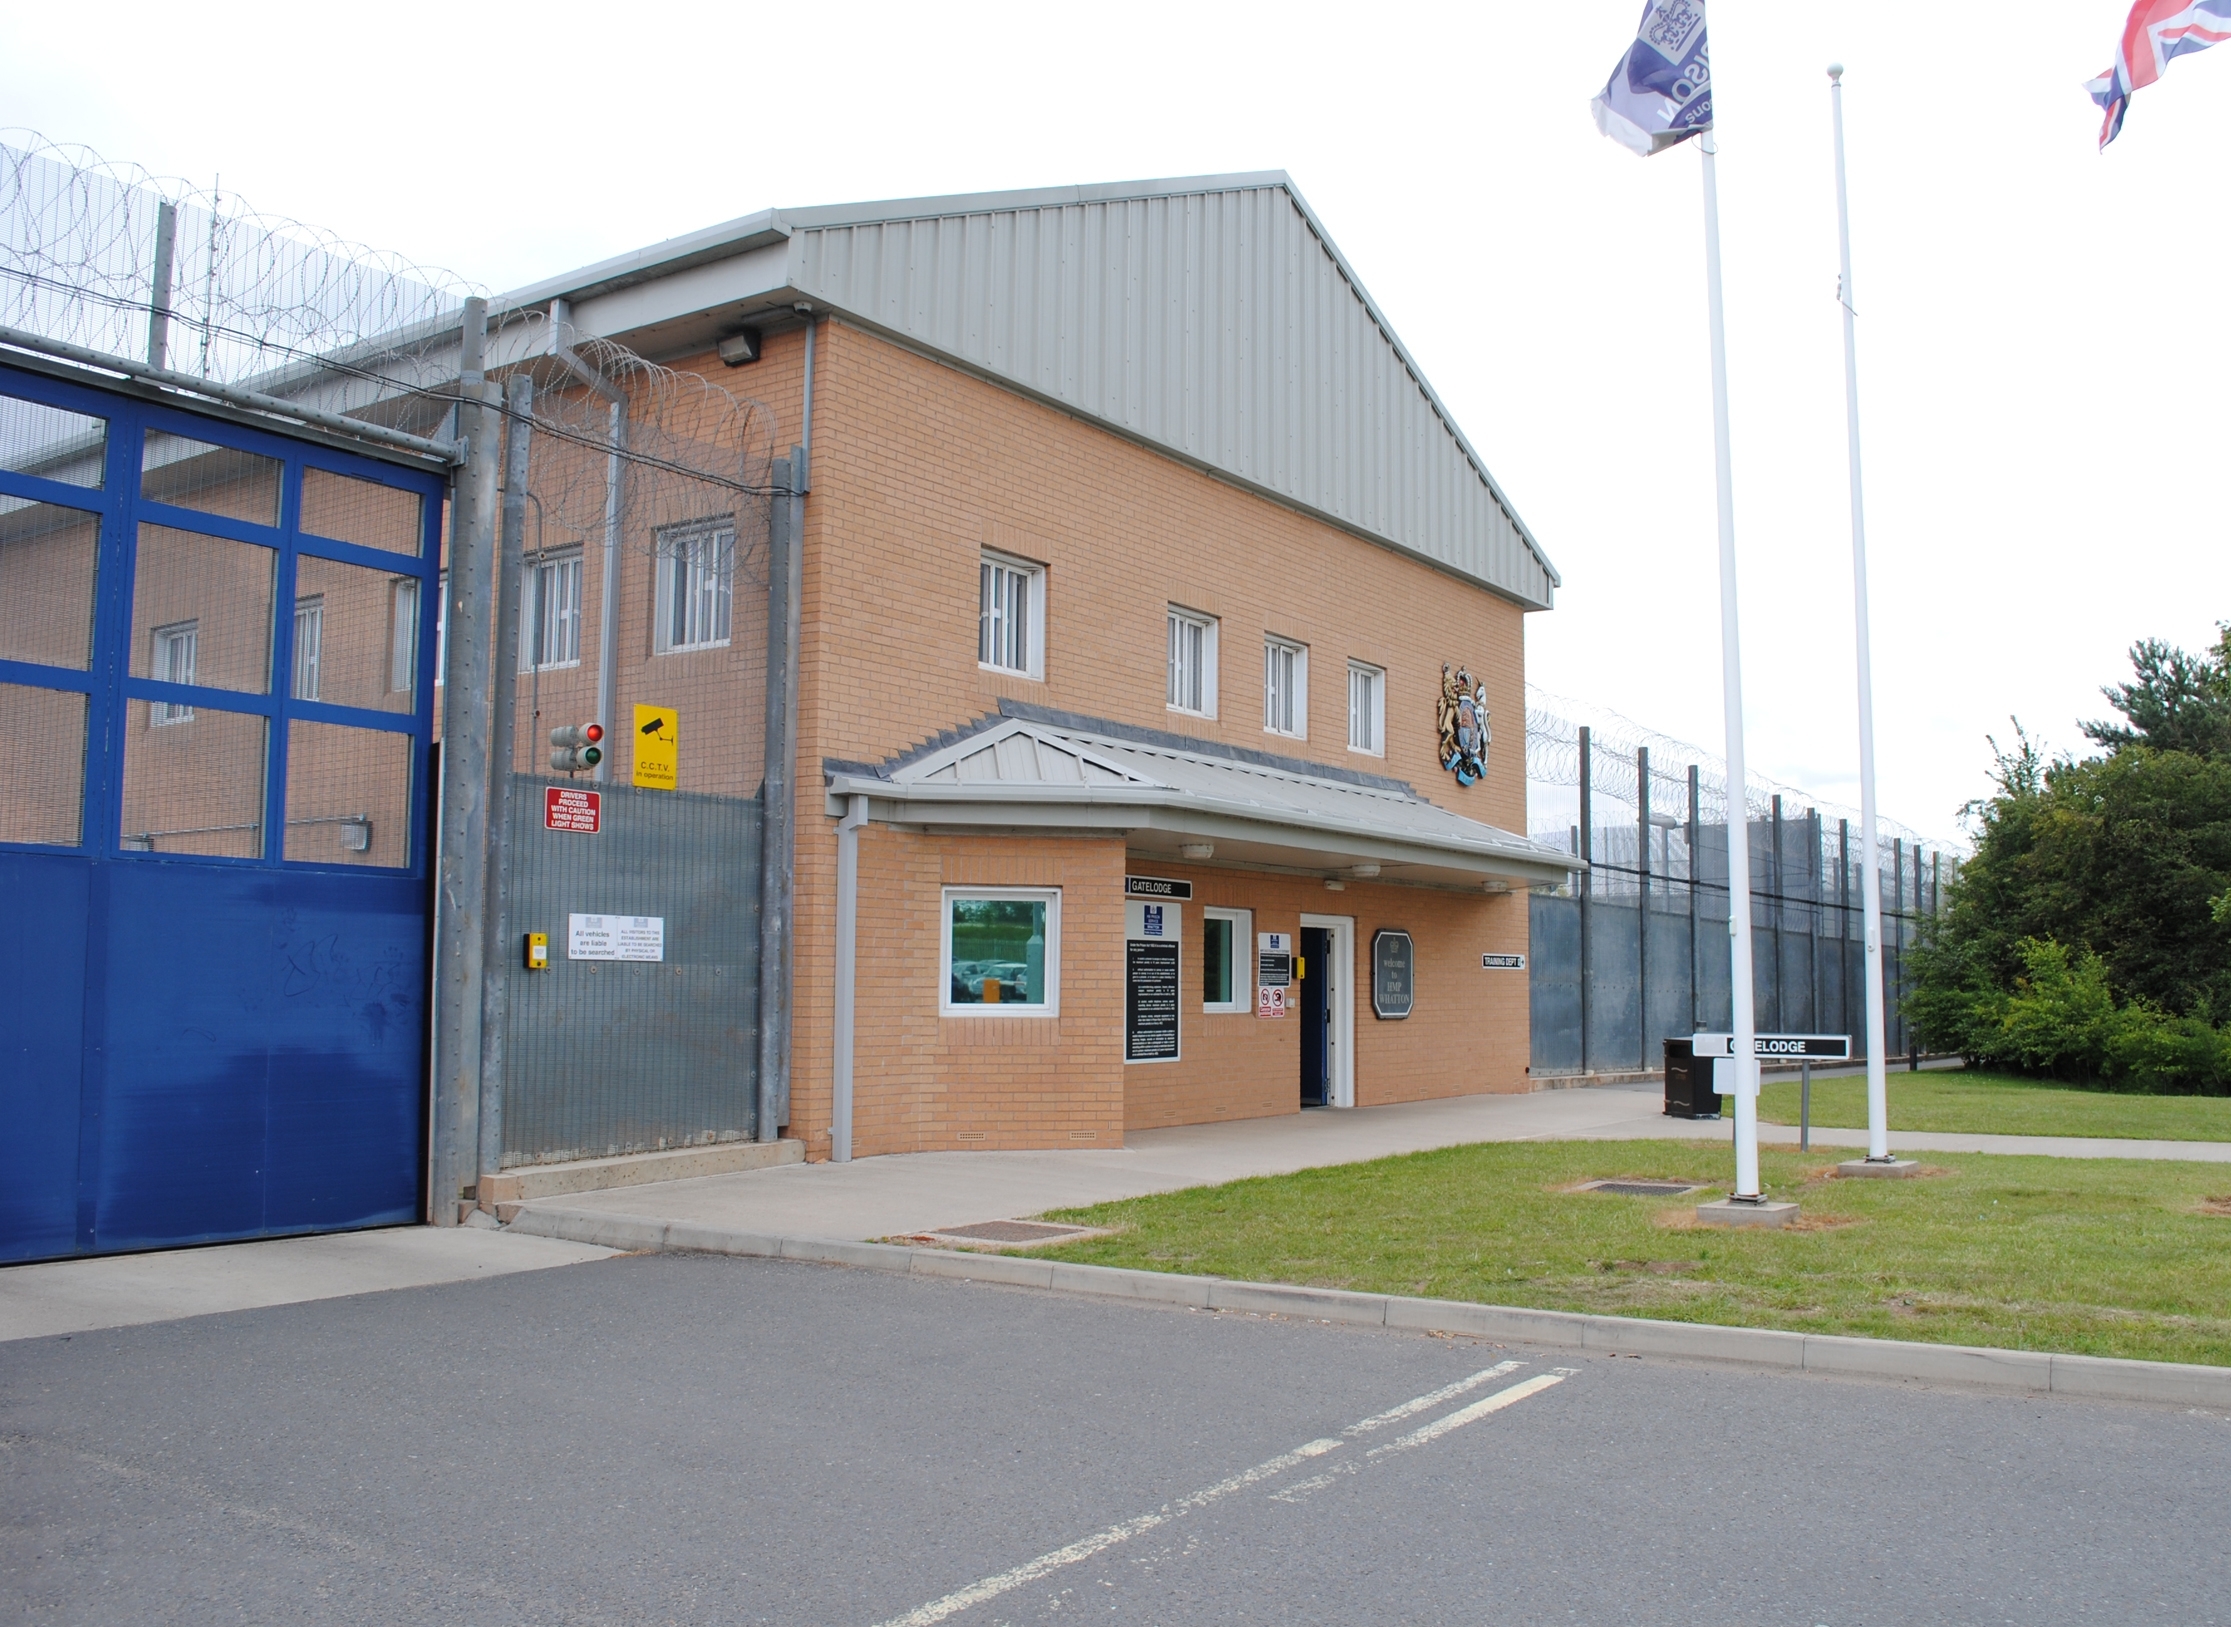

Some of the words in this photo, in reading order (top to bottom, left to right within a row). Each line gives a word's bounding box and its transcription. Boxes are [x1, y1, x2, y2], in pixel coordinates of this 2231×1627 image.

[640, 761, 670, 772] C.C.T.V.
[643, 772, 674, 781] operation
[560, 791, 587, 800] DRIVERS
[558, 798, 589, 808] PROCEED
[550, 804, 568, 813] WITH
[568, 807, 596, 816] CAUTION
[552, 812, 572, 820] WHEN
[572, 815, 594, 823] GREEN
[551, 820, 570, 828] LIGHT
[571, 822, 594, 830] SHOWS
[1131, 880, 1172, 894] GATELODGE
[1383, 957, 1406, 968] welcome
[1484, 956, 1505, 966] TRAINING
[1505, 957, 1517, 966] DEPT
[1391, 970, 1398, 979] to
[1387, 981, 1402, 992] HMP
[1378, 993, 1410, 1004] WHATTON
[1730, 1041, 1806, 1053] ELODGE
